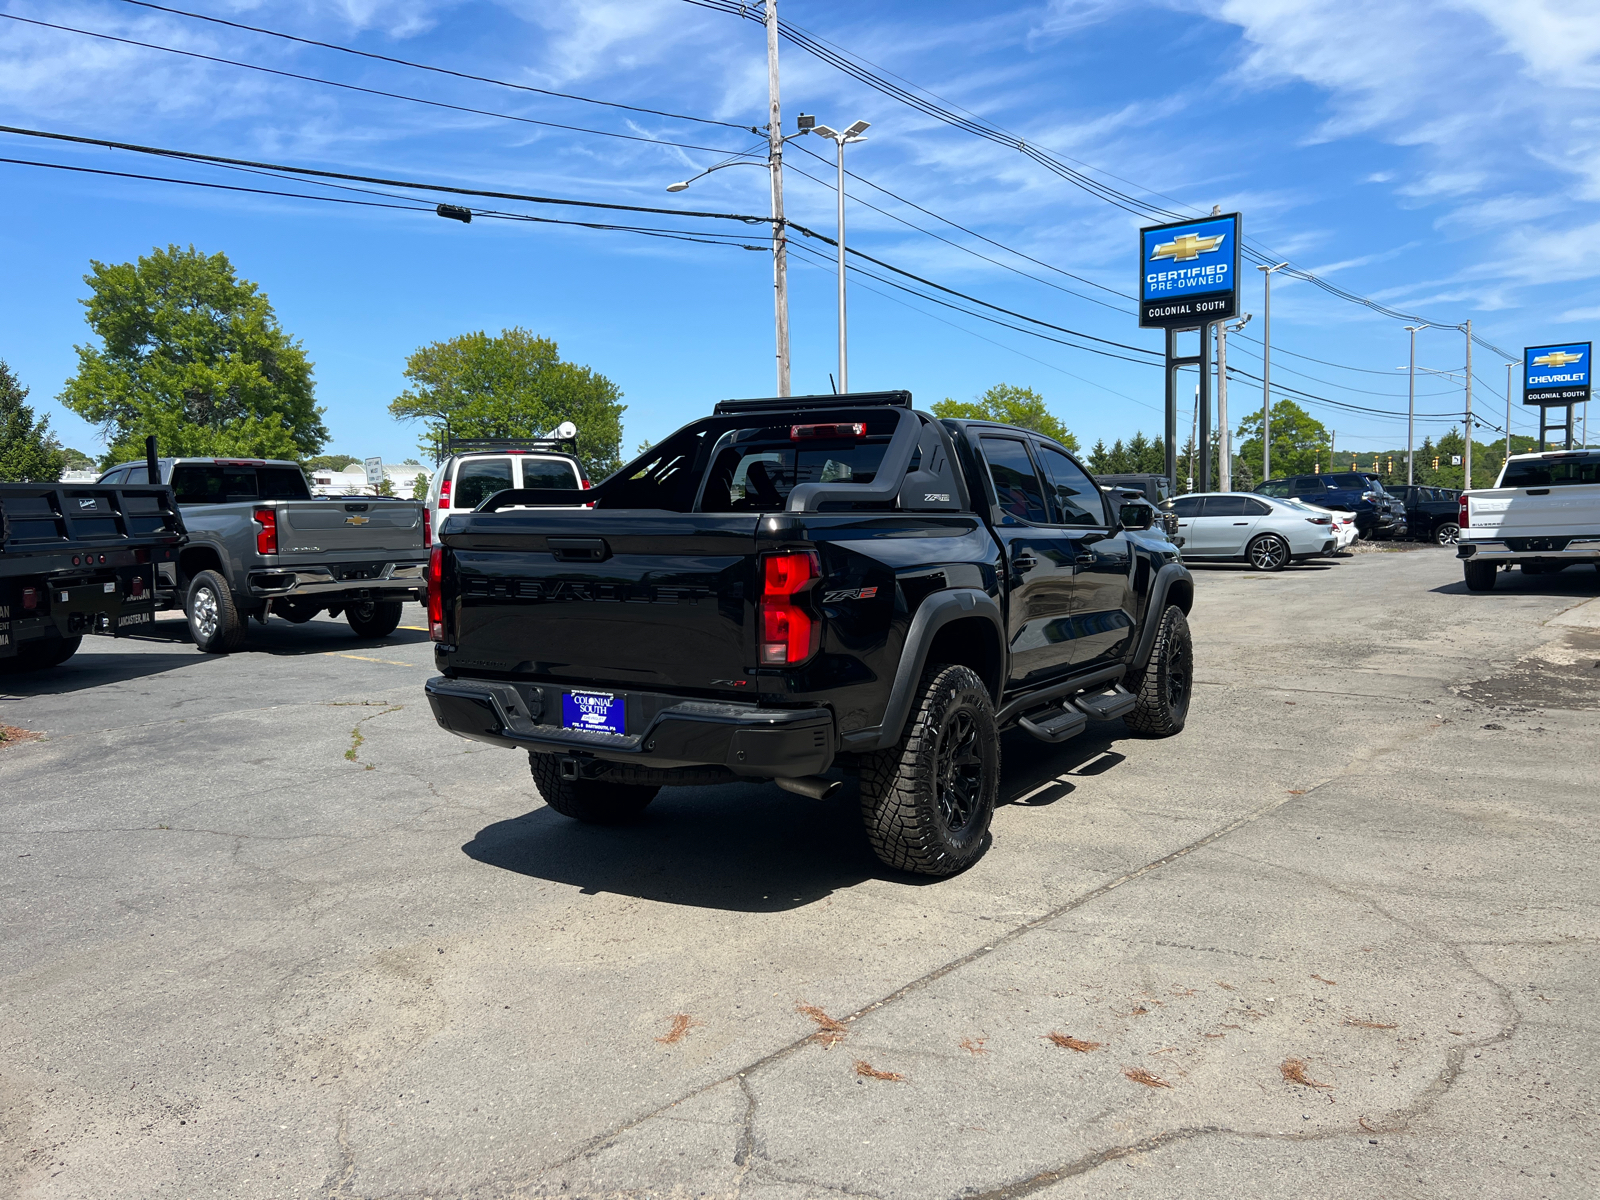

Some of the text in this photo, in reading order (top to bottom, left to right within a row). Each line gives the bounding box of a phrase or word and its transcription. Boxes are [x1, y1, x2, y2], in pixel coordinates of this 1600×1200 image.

[1147, 264, 1228, 283] CERTIFIED
[1150, 274, 1224, 292] PRE-OWNED
[1148, 300, 1225, 317] COLONIAL SOUTH
[1529, 372, 1586, 384] CHEVROLET
[1528, 392, 1561, 400] COLONIAL
[822, 586, 878, 603] ZR2
[573, 696, 613, 707] COLONIAL
[580, 705, 607, 715] SOUTH
